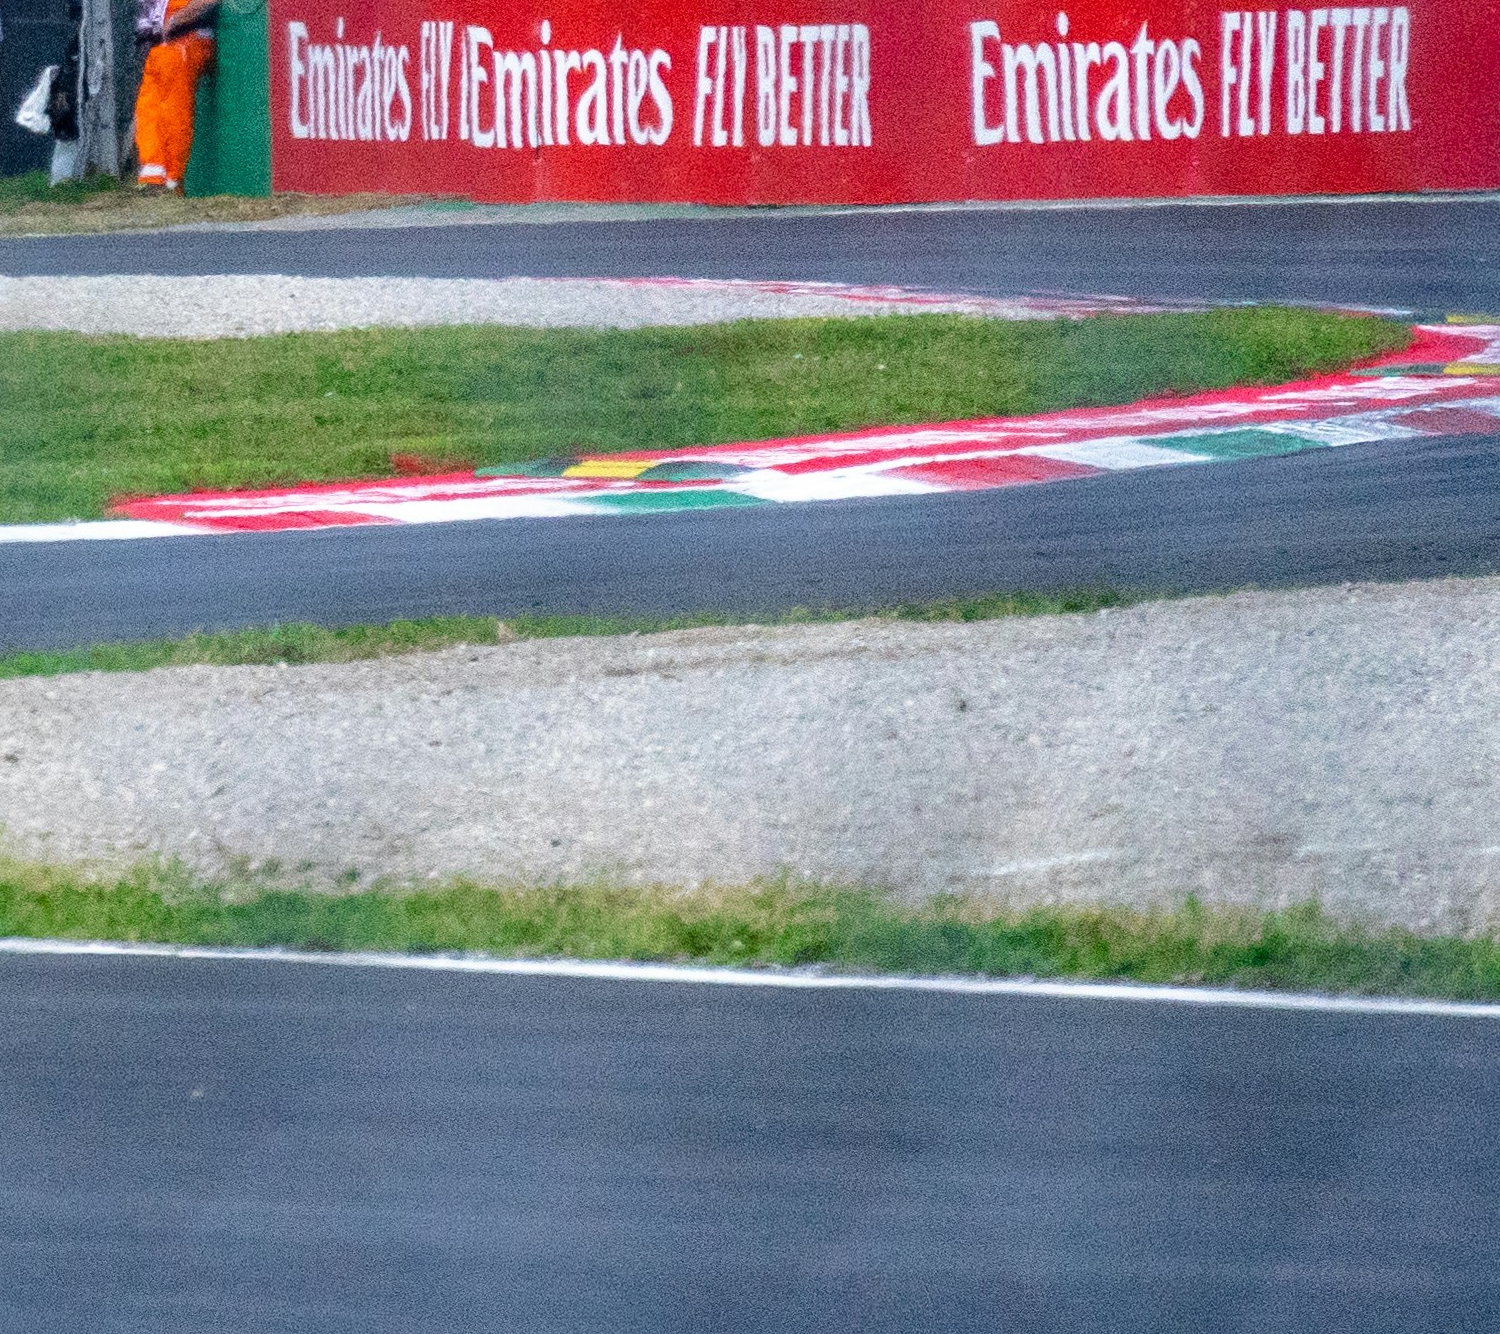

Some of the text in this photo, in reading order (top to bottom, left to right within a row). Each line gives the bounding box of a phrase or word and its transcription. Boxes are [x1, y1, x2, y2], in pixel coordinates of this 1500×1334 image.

[287, 17, 412, 141] Emirates
[421, 21, 453, 140] FLY
[466, 19, 673, 148] Emirates
[693, 25, 746, 148] FLY
[755, 23, 872, 147] BETTER
[969, 6, 1412, 146] Emirates FLY BETTER
